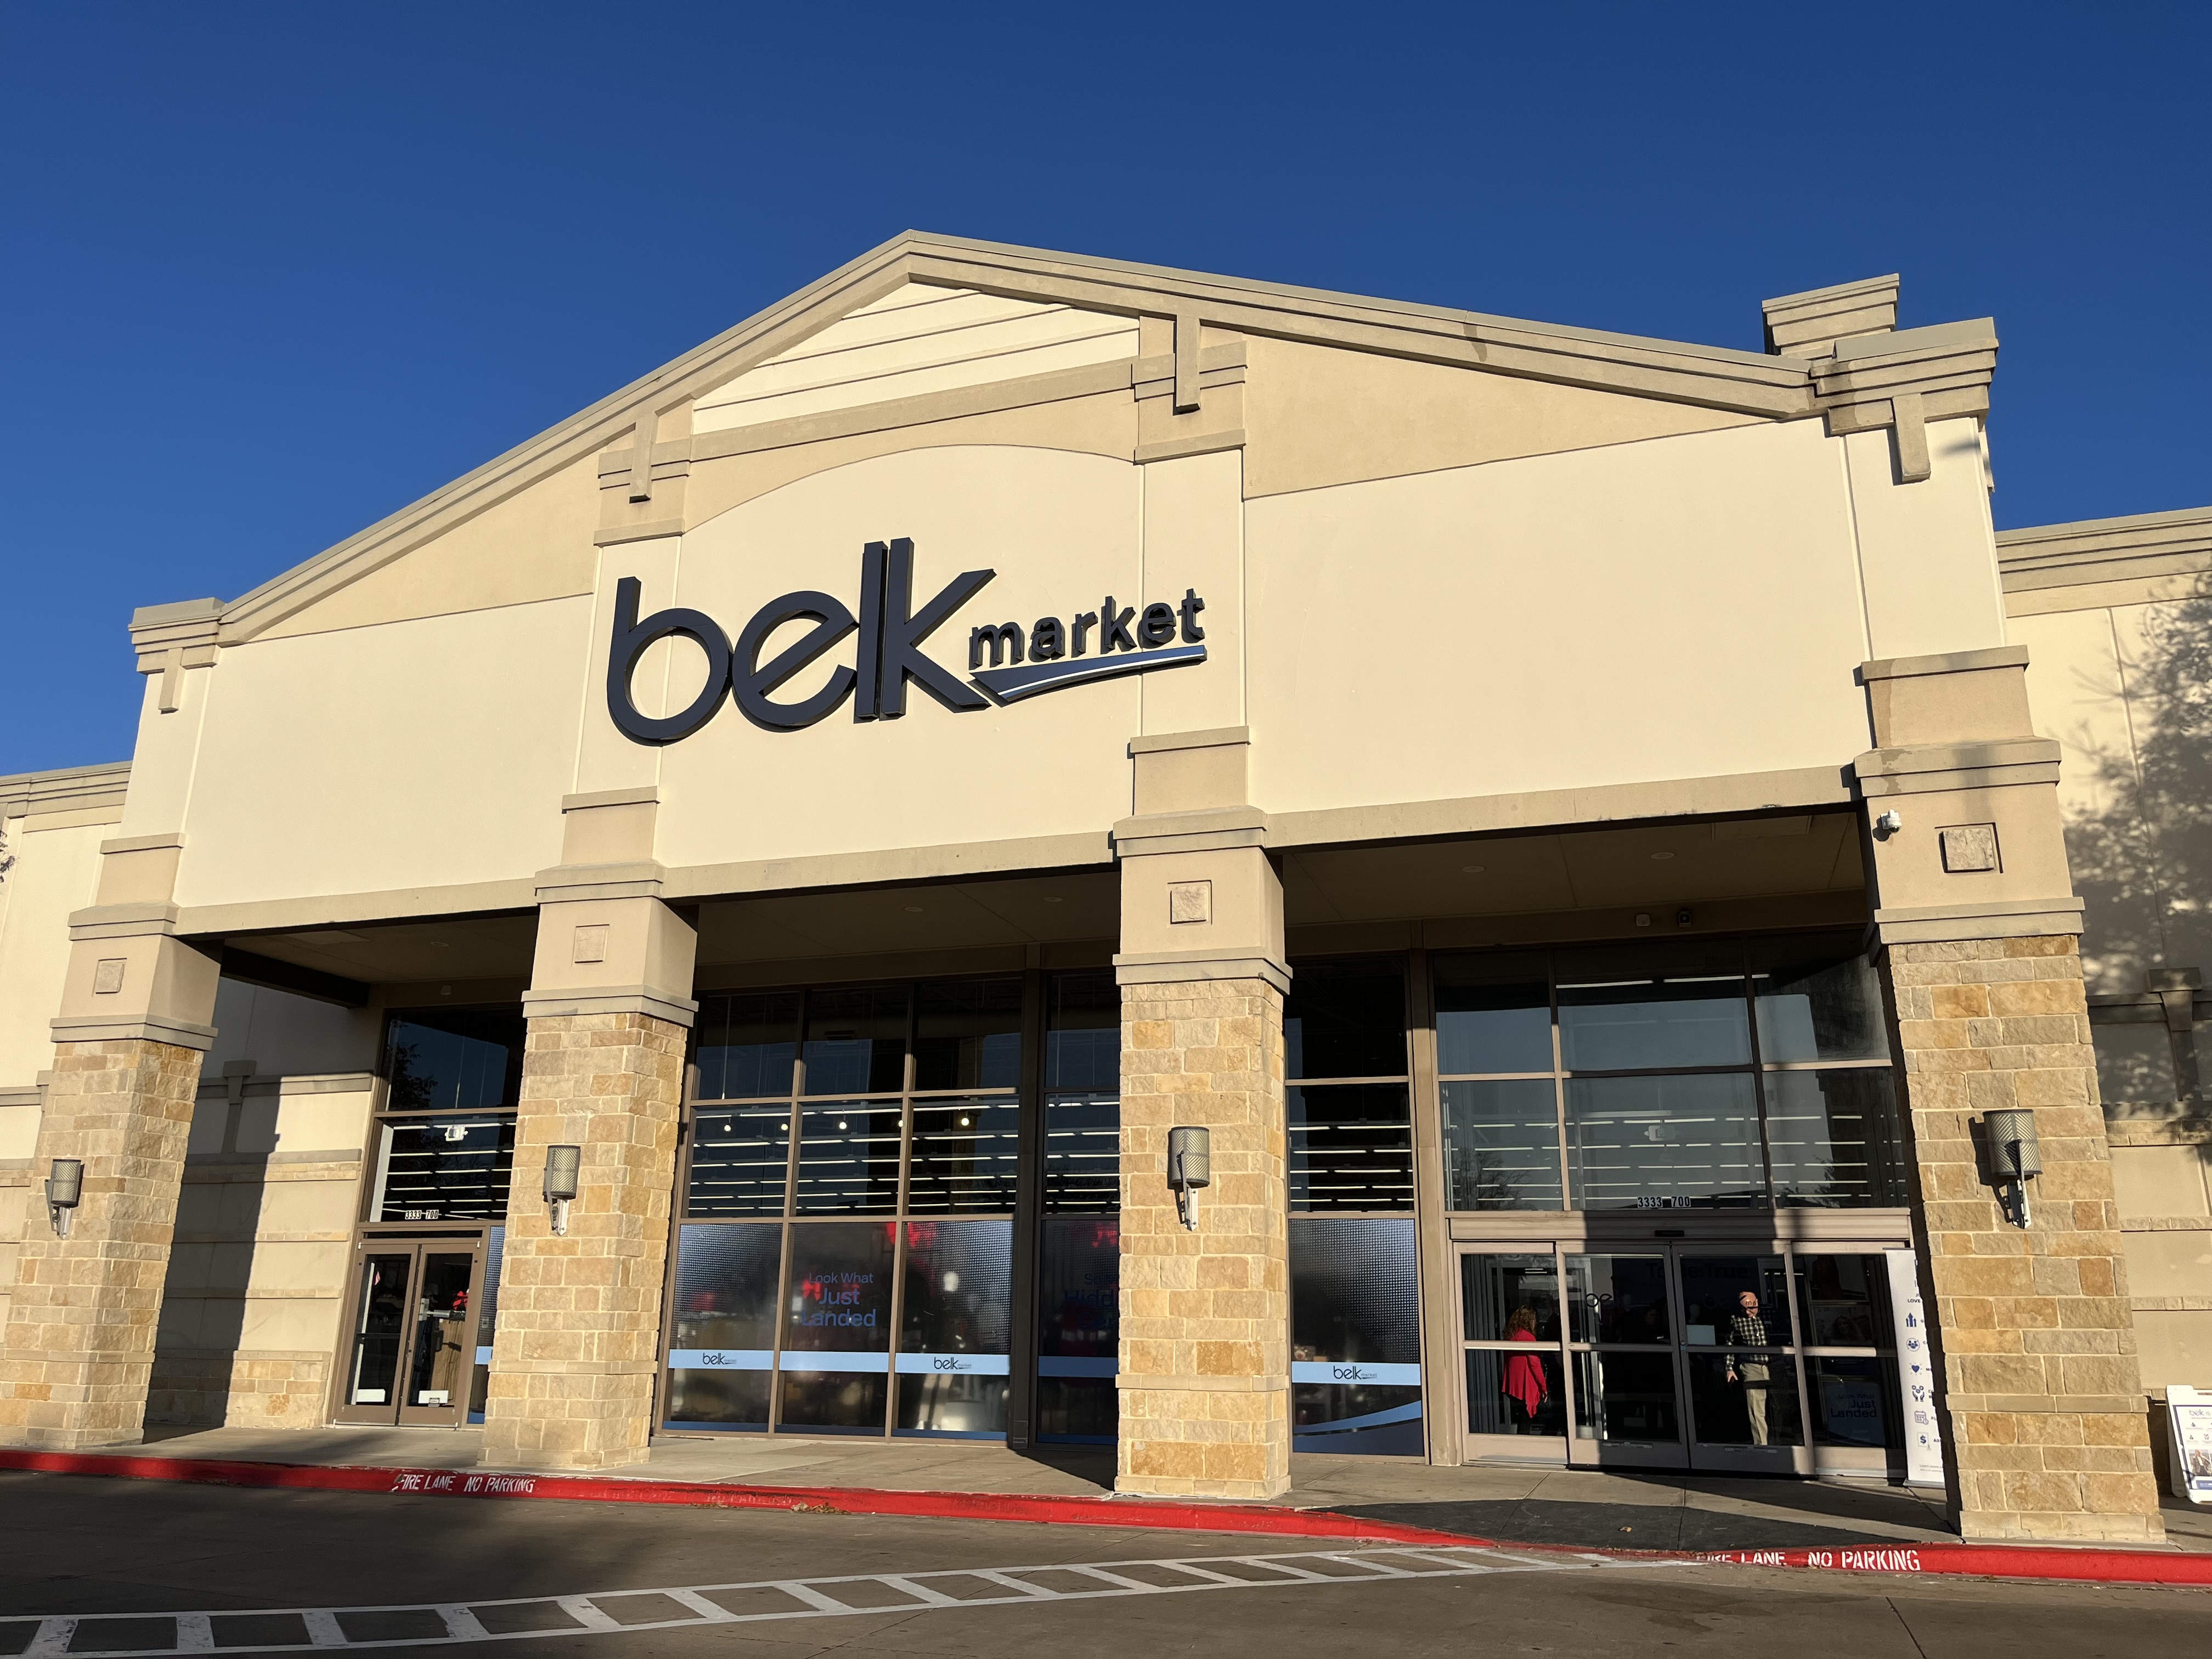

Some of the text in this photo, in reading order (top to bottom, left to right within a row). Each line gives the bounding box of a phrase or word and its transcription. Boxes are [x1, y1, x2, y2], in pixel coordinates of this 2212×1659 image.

[607, 537, 1206, 747] belk market
[1638, 1196, 1690, 1207] 3333 700
[405, 1210, 438, 1219] 3333 700
[809, 1272, 874, 1284] Look What
[819, 1287, 861, 1305] Just
[1065, 1289, 1114, 1307] Hidd
[801, 1307, 877, 1327] Landed
[702, 1352, 725, 1365] belk
[934, 1356, 959, 1370] belk
[1333, 1365, 1362, 1380] belk
[1851, 1399, 1876, 1408] Just
[1831, 1408, 1877, 1418] Landed
[401, 1474, 536, 1493] FIRE LANE NO PARKING
[1741, 1551, 1787, 1565] LANE
[1808, 1551, 1832, 1567] NO
[1842, 1549, 1921, 1571] PARKING
